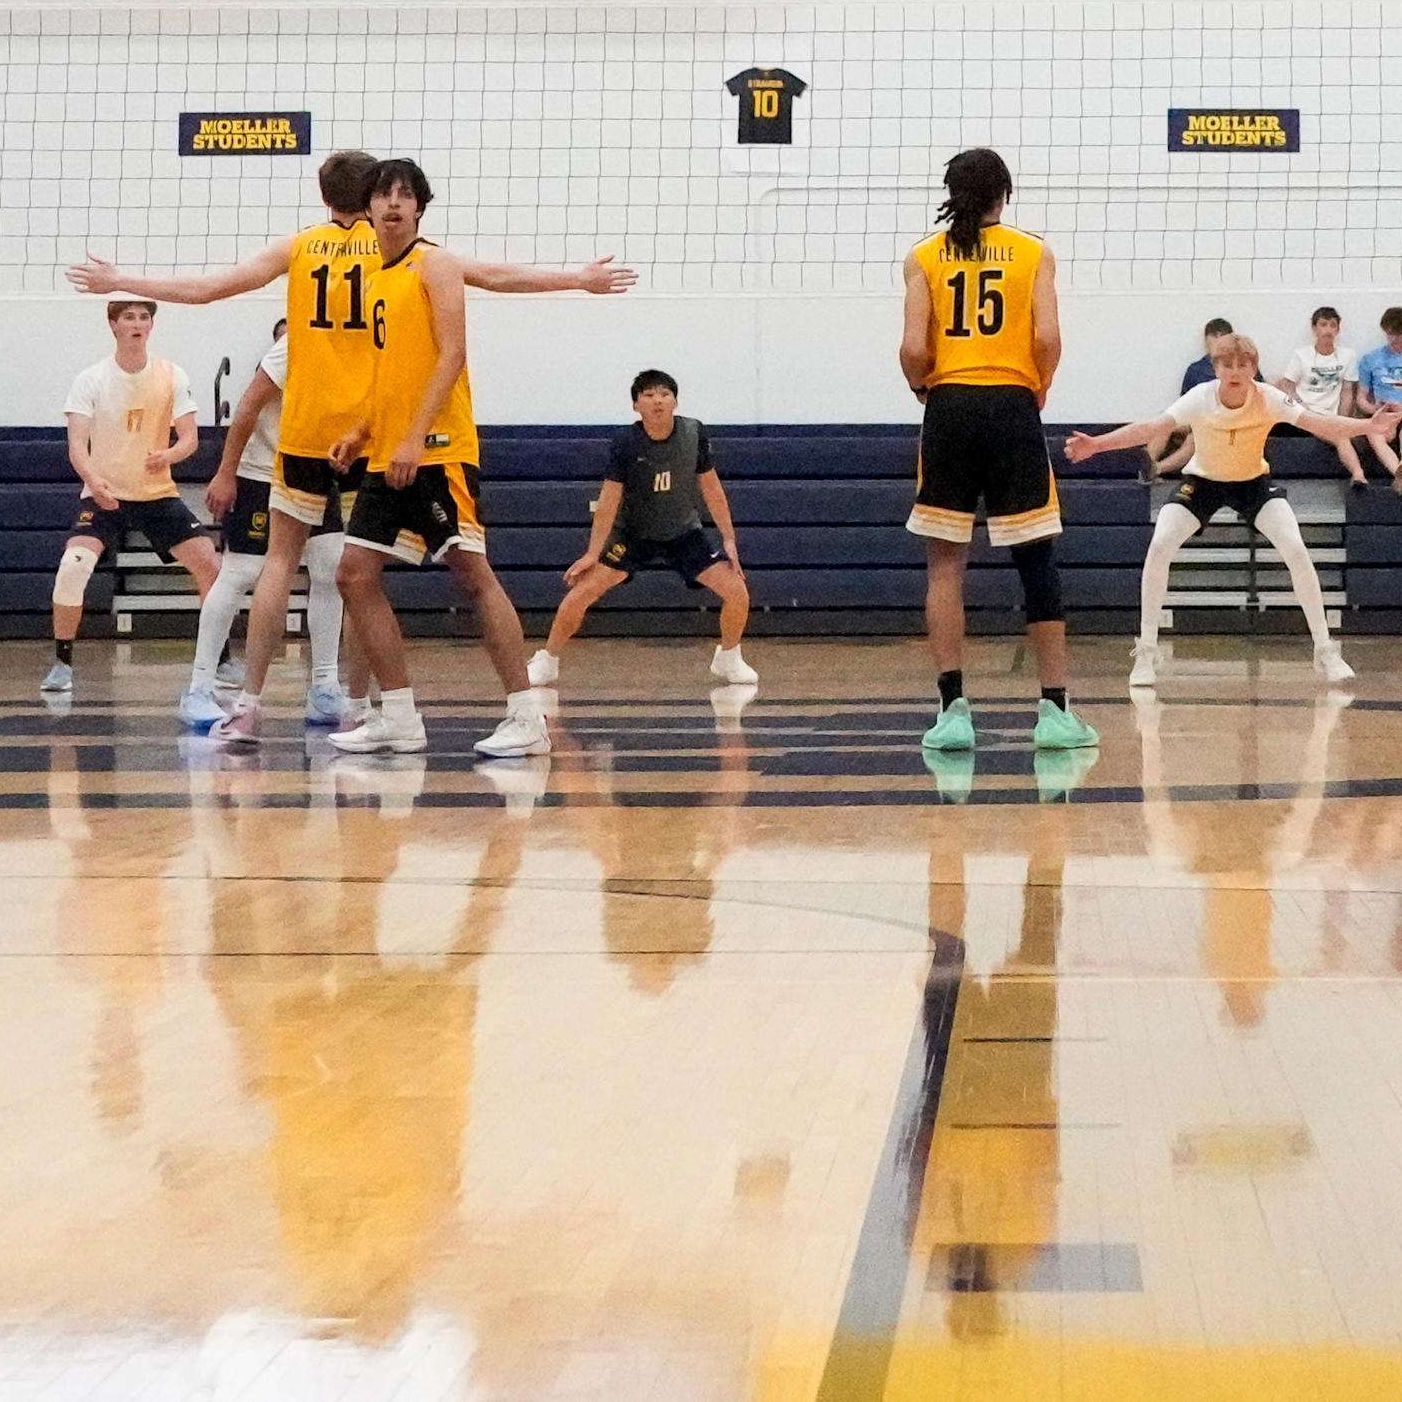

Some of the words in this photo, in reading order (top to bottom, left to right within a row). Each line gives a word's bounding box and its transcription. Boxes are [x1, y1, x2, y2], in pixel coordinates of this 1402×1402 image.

[753, 90, 778, 118] 10
[200, 119, 291, 134] MOELLER
[1188, 115, 1280, 130] MOELLER
[193, 134, 297, 149] STUDENTS
[1182, 131, 1286, 146] STUDENTS
[310, 264, 368, 329] 11
[945, 270, 1003, 337] 15
[373, 299, 386, 350] 6
[653, 470, 671, 493] 10
